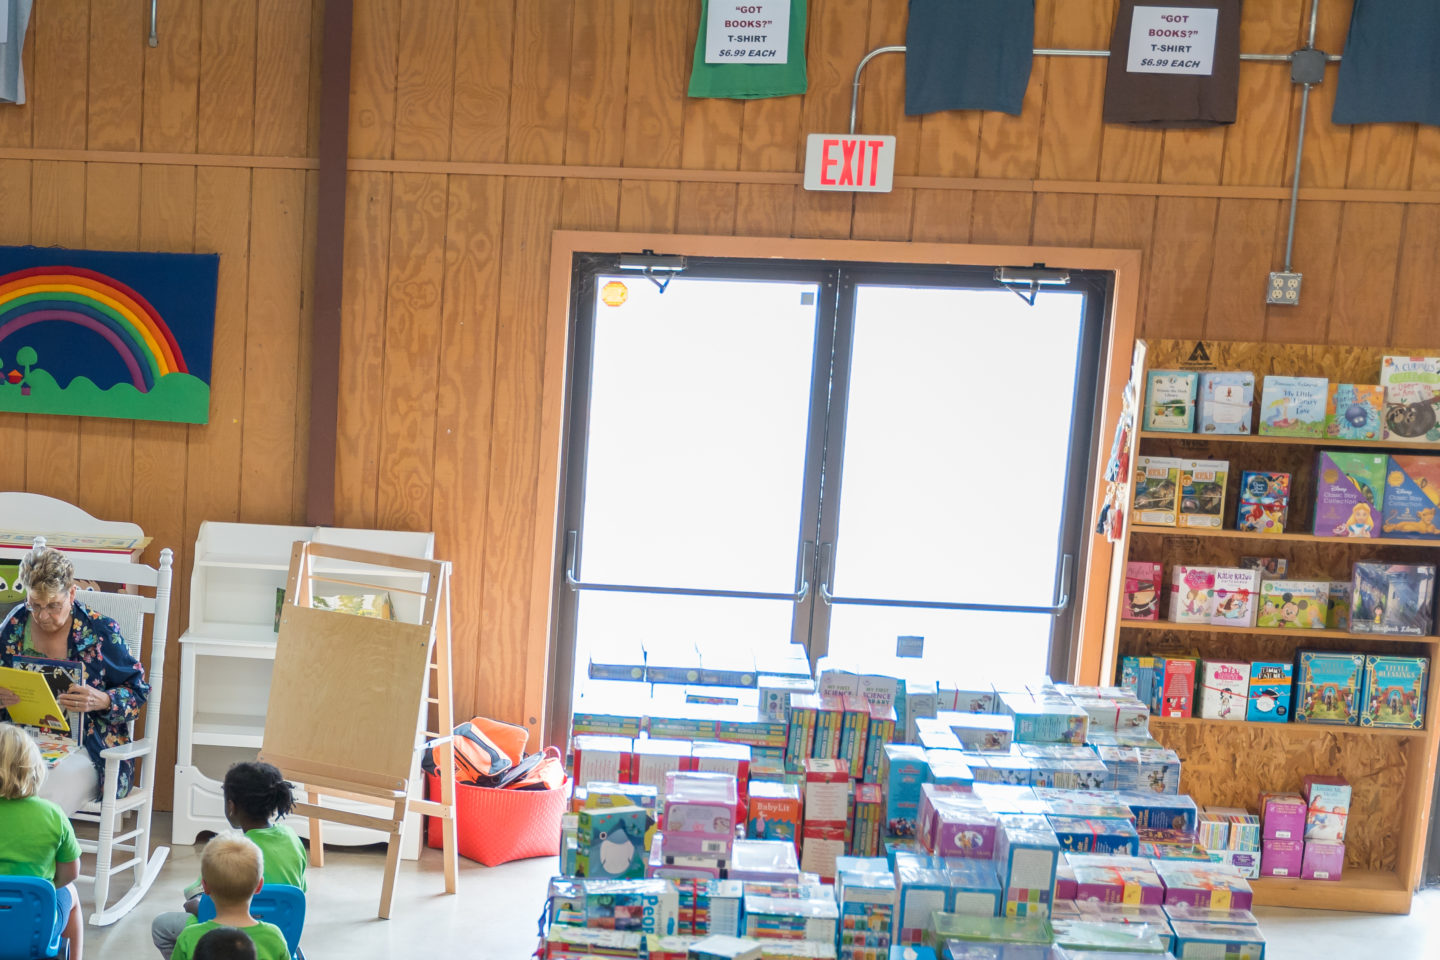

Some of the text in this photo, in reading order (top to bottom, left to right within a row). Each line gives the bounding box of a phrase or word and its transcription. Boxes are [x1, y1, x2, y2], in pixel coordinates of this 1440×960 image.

[735, 6, 763, 14] "GOT
[1161, 14, 1190, 24] "GOT
[724, 20, 773, 29] BOOKS?"
[1148, 28, 1199, 38] BOOKS?"
[728, 35, 768, 43] T-SHIRT
[1151, 44, 1192, 53] T-SHIRT
[718, 49, 777, 58] $6.99 EACH
[1140, 58, 1201, 69] $6.99 EACH
[820, 139, 885, 187] EXIT
